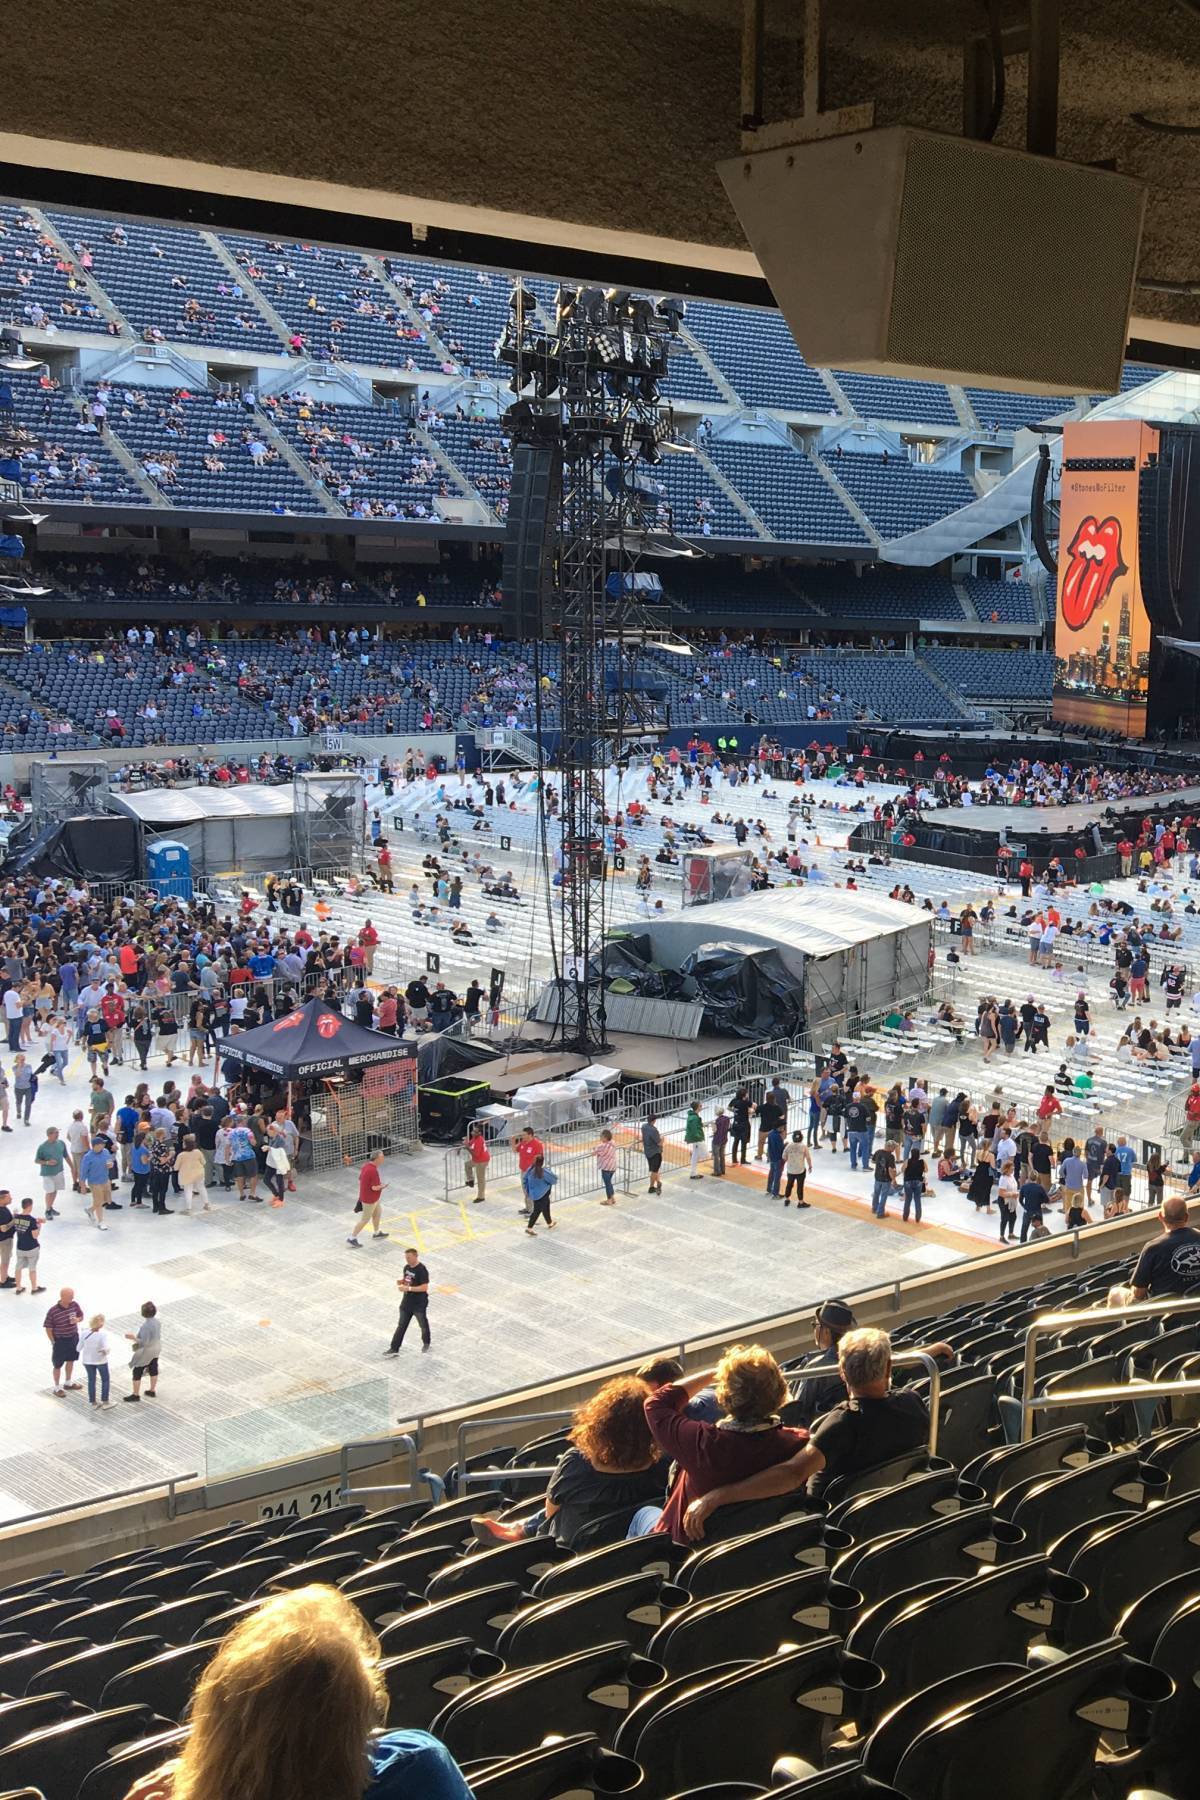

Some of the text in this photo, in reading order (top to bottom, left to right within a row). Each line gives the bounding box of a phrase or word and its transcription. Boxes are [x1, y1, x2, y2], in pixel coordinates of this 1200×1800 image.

[1071, 483, 1126, 492] #StonesNoFilter
[503, 838, 509, 848] G
[616, 858, 622, 869] C
[954, 921, 961, 932] F
[430, 956, 437, 970] K
[494, 973, 501, 985] J
[218, 1044, 284, 1075] OFFICIAL MERCHANDISE
[298, 1048, 409, 1075] OFFICIAL MERCHANDISE
[262, 1499, 300, 1520] 214
